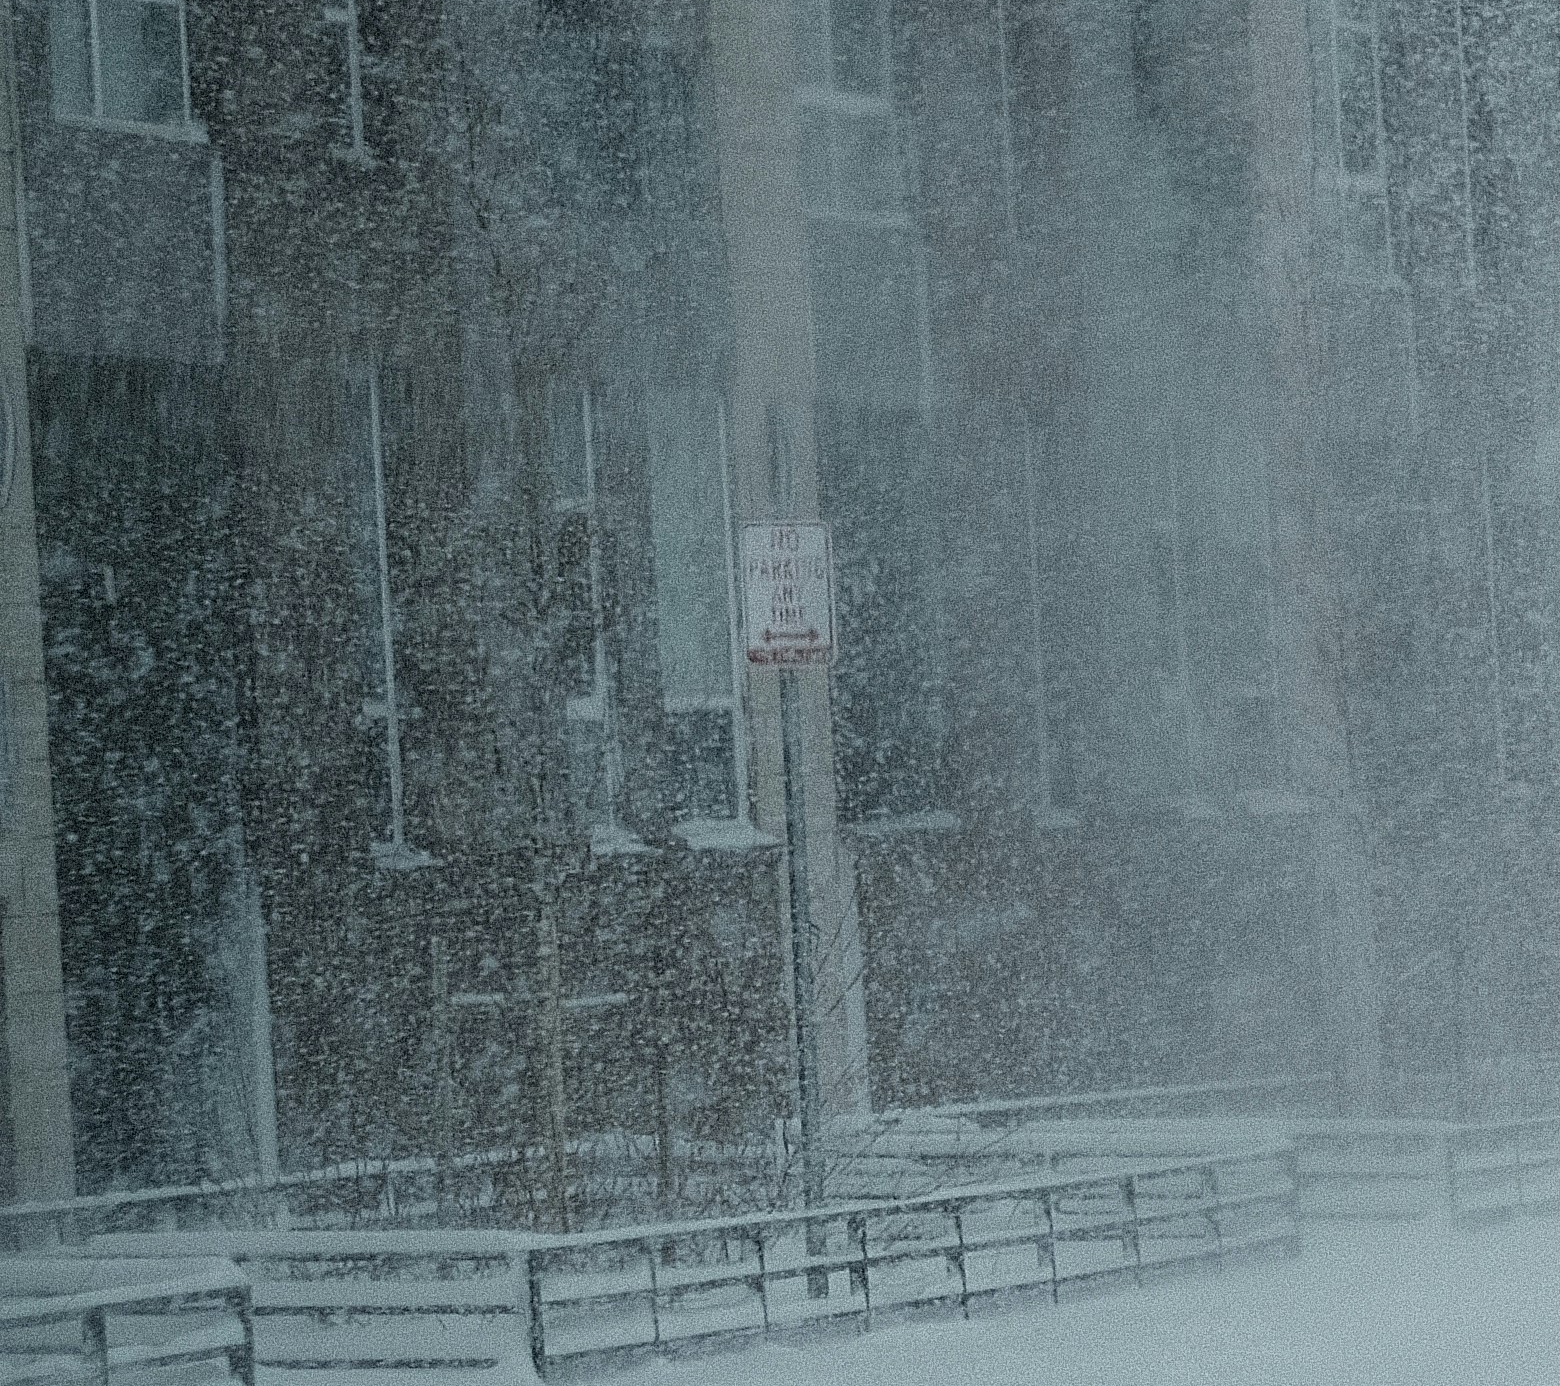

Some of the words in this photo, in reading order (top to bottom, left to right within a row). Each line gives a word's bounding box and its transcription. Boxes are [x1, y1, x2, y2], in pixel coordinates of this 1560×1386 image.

[770, 529, 801, 552] NO
[748, 558, 825, 581] PARKING
[772, 584, 803, 604] ANY
[771, 606, 806, 626] TIME
